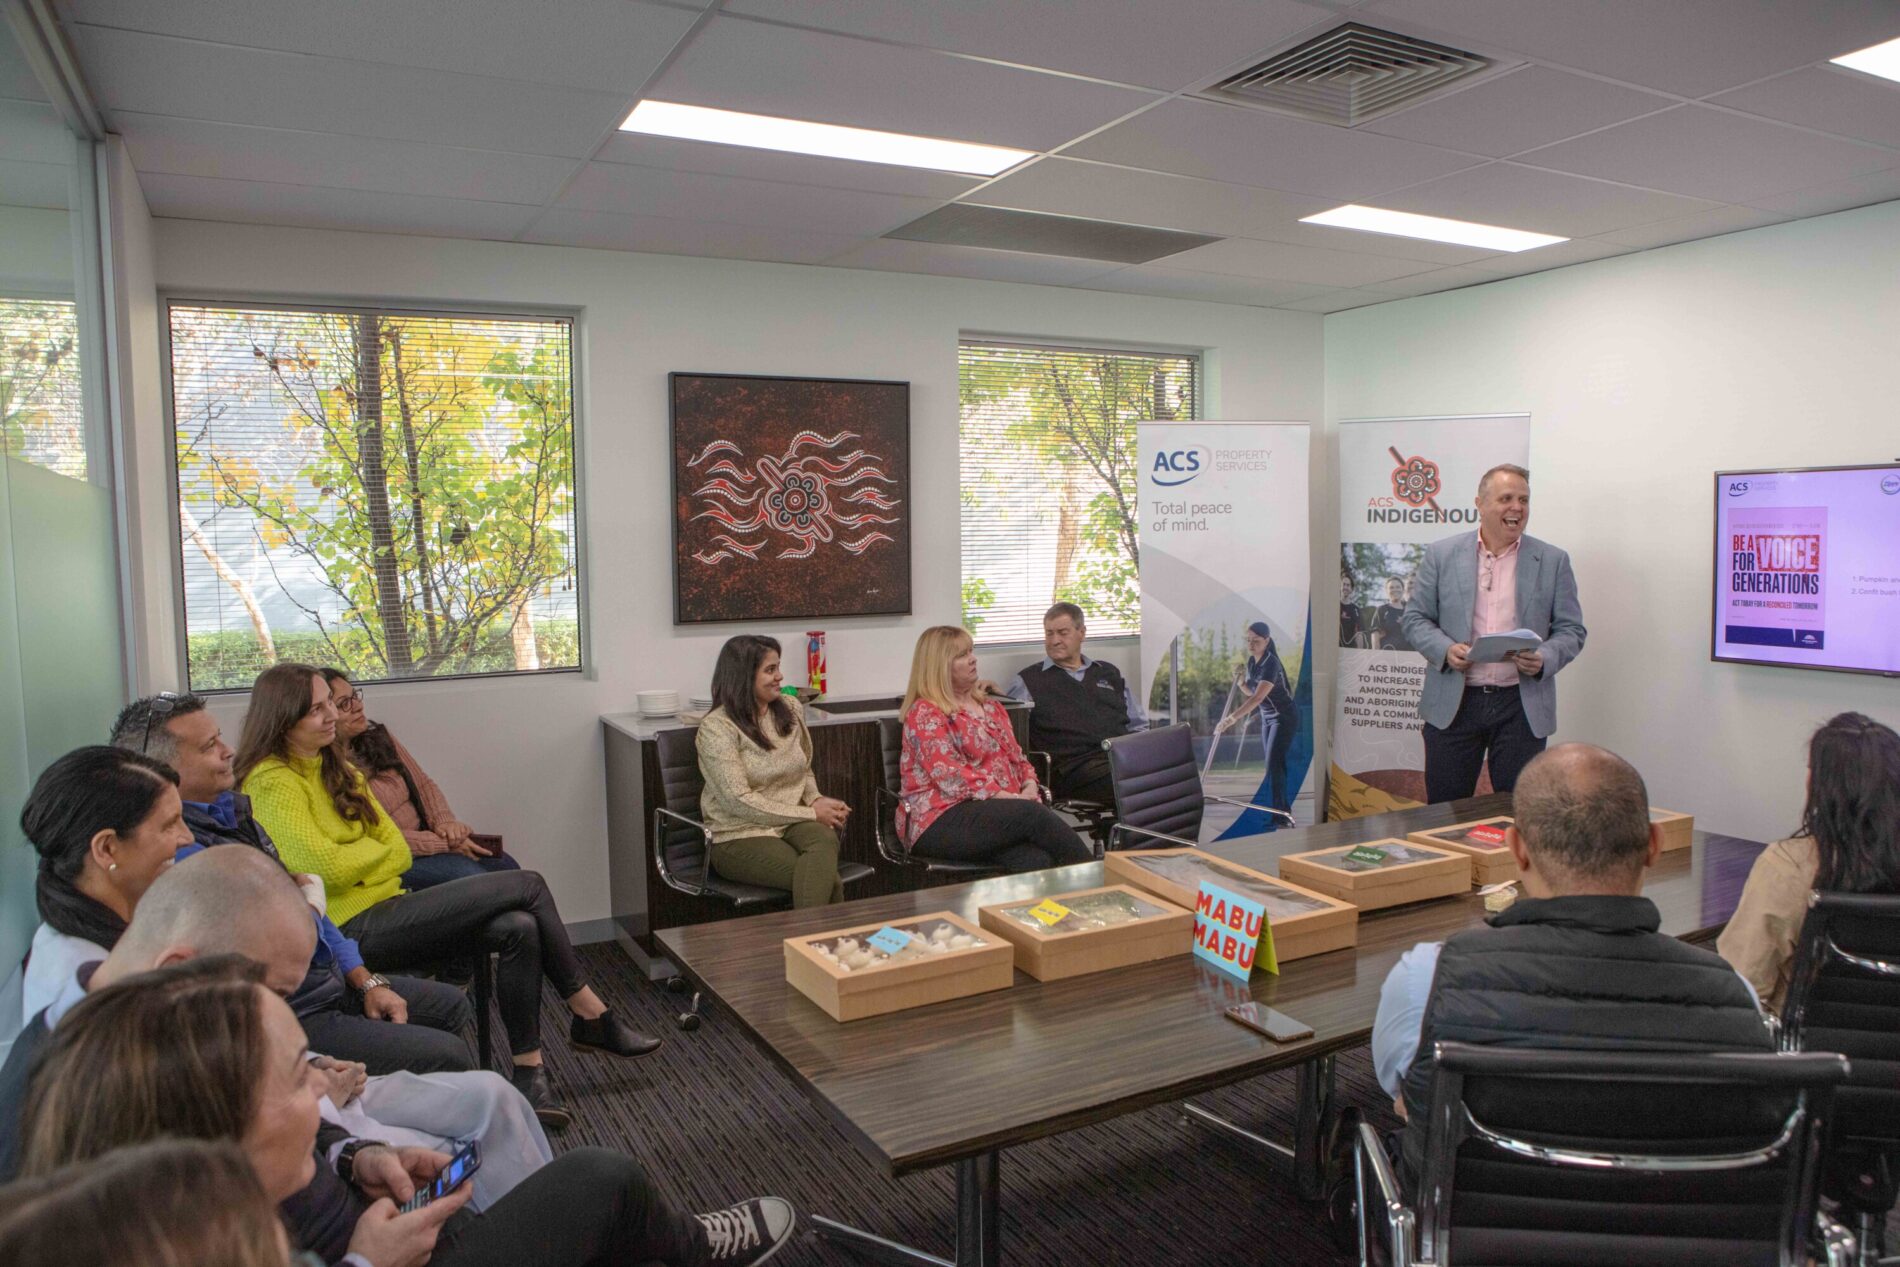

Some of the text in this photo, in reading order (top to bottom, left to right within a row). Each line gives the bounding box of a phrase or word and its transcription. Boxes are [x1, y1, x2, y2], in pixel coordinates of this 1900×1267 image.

[1215, 449, 1272, 460] PROPERTY
[1153, 450, 1200, 472] ACS
[1215, 461, 1267, 471] SERVICES
[1729, 482, 1749, 492] ACS
[1368, 497, 1394, 508] ACS
[1152, 501, 1232, 517] Total peace
[1367, 508, 1481, 524] INDIGENOU
[1152, 518, 1209, 532] of mind.
[1733, 534, 1819, 571] BE A VOICE
[1732, 552, 1755, 571] FOR
[1732, 572, 1819, 595] GENERATIONS
[1732, 599, 1740, 607] ACT
[1740, 599, 1754, 607] TODAY
[1368, 664, 1427, 675] ACS INDIGE
[1358, 675, 1421, 686] TO INCREASE
[1359, 686, 1408, 697] AMONGST
[1345, 696, 1365, 705] AND
[1344, 706, 1371, 716] BUILD
[1373, 709, 1381, 717] A
[1351, 719, 1403, 730] SUPPLIERS
[1195, 889, 1263, 939] MABU
[1193, 919, 1257, 970] MABU
